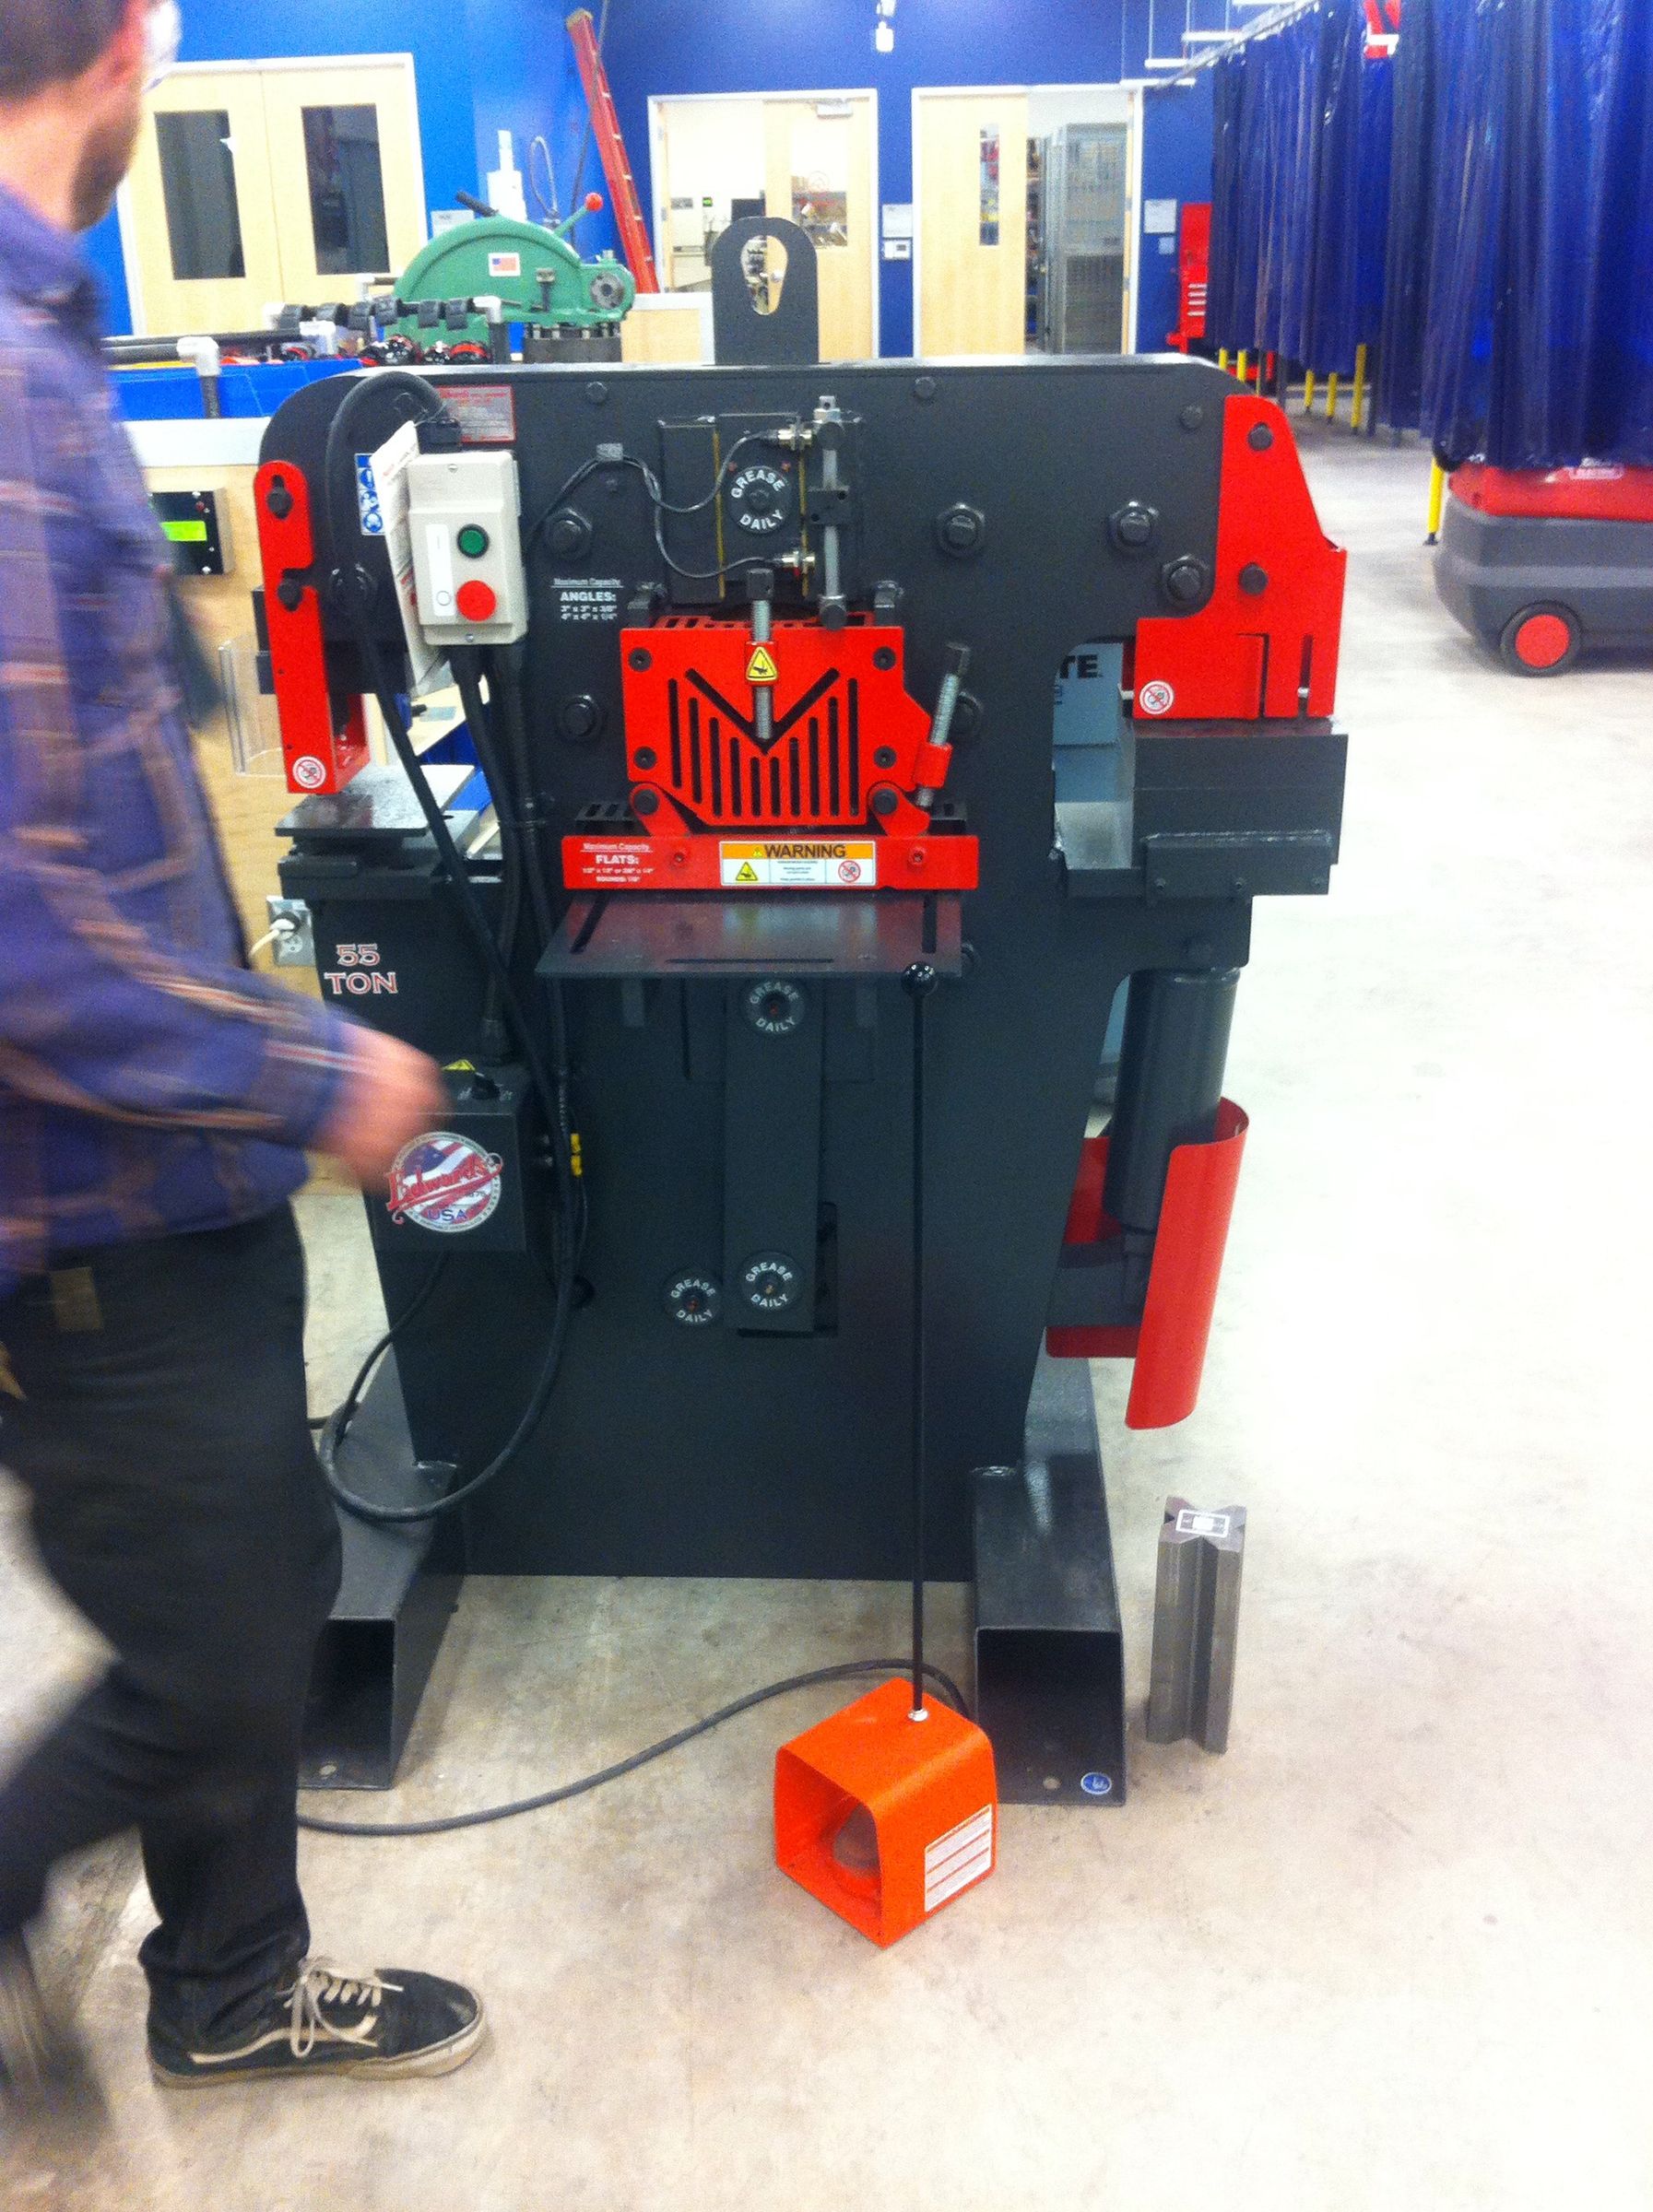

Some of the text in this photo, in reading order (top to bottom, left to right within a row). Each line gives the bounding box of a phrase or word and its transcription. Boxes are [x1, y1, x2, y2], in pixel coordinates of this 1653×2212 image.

[730, 469, 785, 499] GREASE
[739, 509, 783, 530] DAILY
[560, 591, 617, 602] ANGLES:
[596, 854, 640, 865] FLATS:
[764, 844, 846, 858] WARNING
[336, 942, 381, 967] 55
[324, 971, 398, 994] TON
[750, 981, 799, 1005] GREASE
[755, 1016, 796, 1032] DAILY
[427, 1208, 467, 1221] USA
[745, 1262, 793, 1282] GREASE
[670, 1278, 715, 1299] GREASE
[750, 1293, 788, 1307] DAILY
[676, 1309, 713, 1323] DAILY
